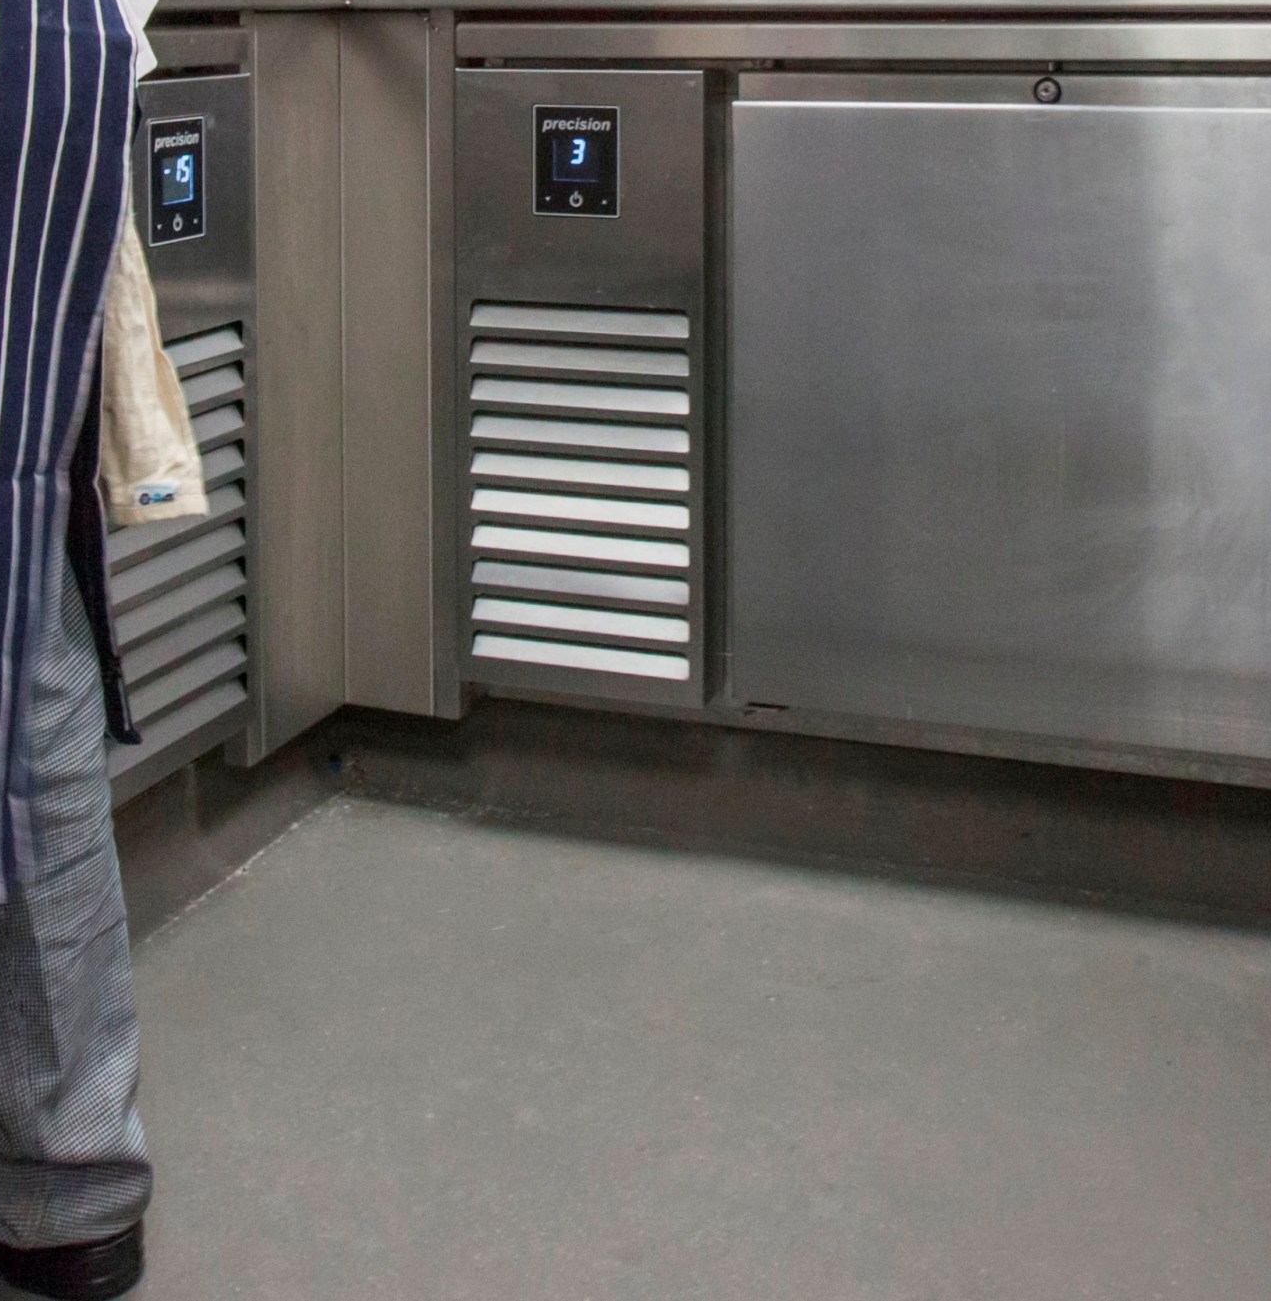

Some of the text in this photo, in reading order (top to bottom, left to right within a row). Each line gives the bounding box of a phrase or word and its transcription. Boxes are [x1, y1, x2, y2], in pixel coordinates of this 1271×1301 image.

[542, 116, 612, 133] precision
[154, 131, 200, 153] precision
[569, 138, 587, 166] 3
